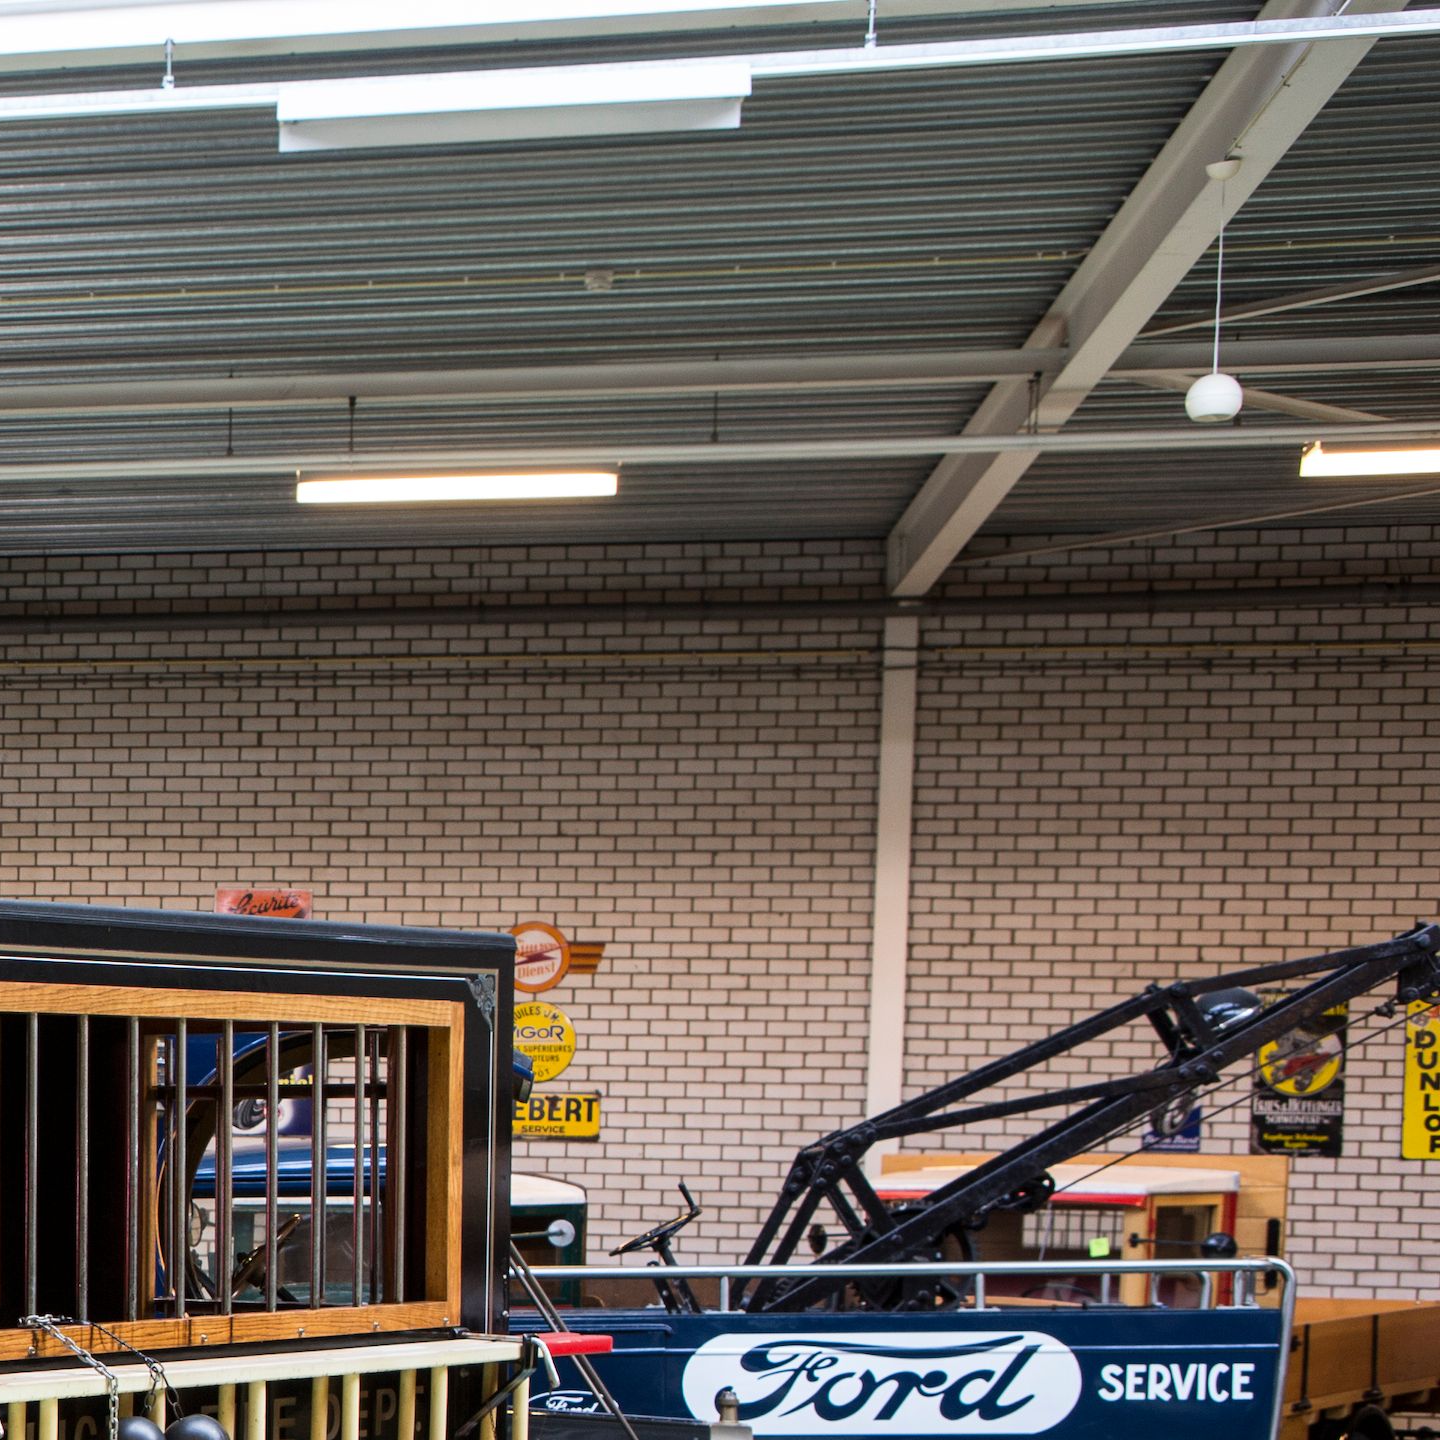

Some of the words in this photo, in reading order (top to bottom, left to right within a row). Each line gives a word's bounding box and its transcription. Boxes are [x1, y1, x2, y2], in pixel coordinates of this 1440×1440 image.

[514, 1006, 541, 1021] UILES
[521, 1124, 566, 1134] SERVICE
[714, 1334, 1042, 1422] Ford
[1098, 1362, 1255, 1403] SERVICE
